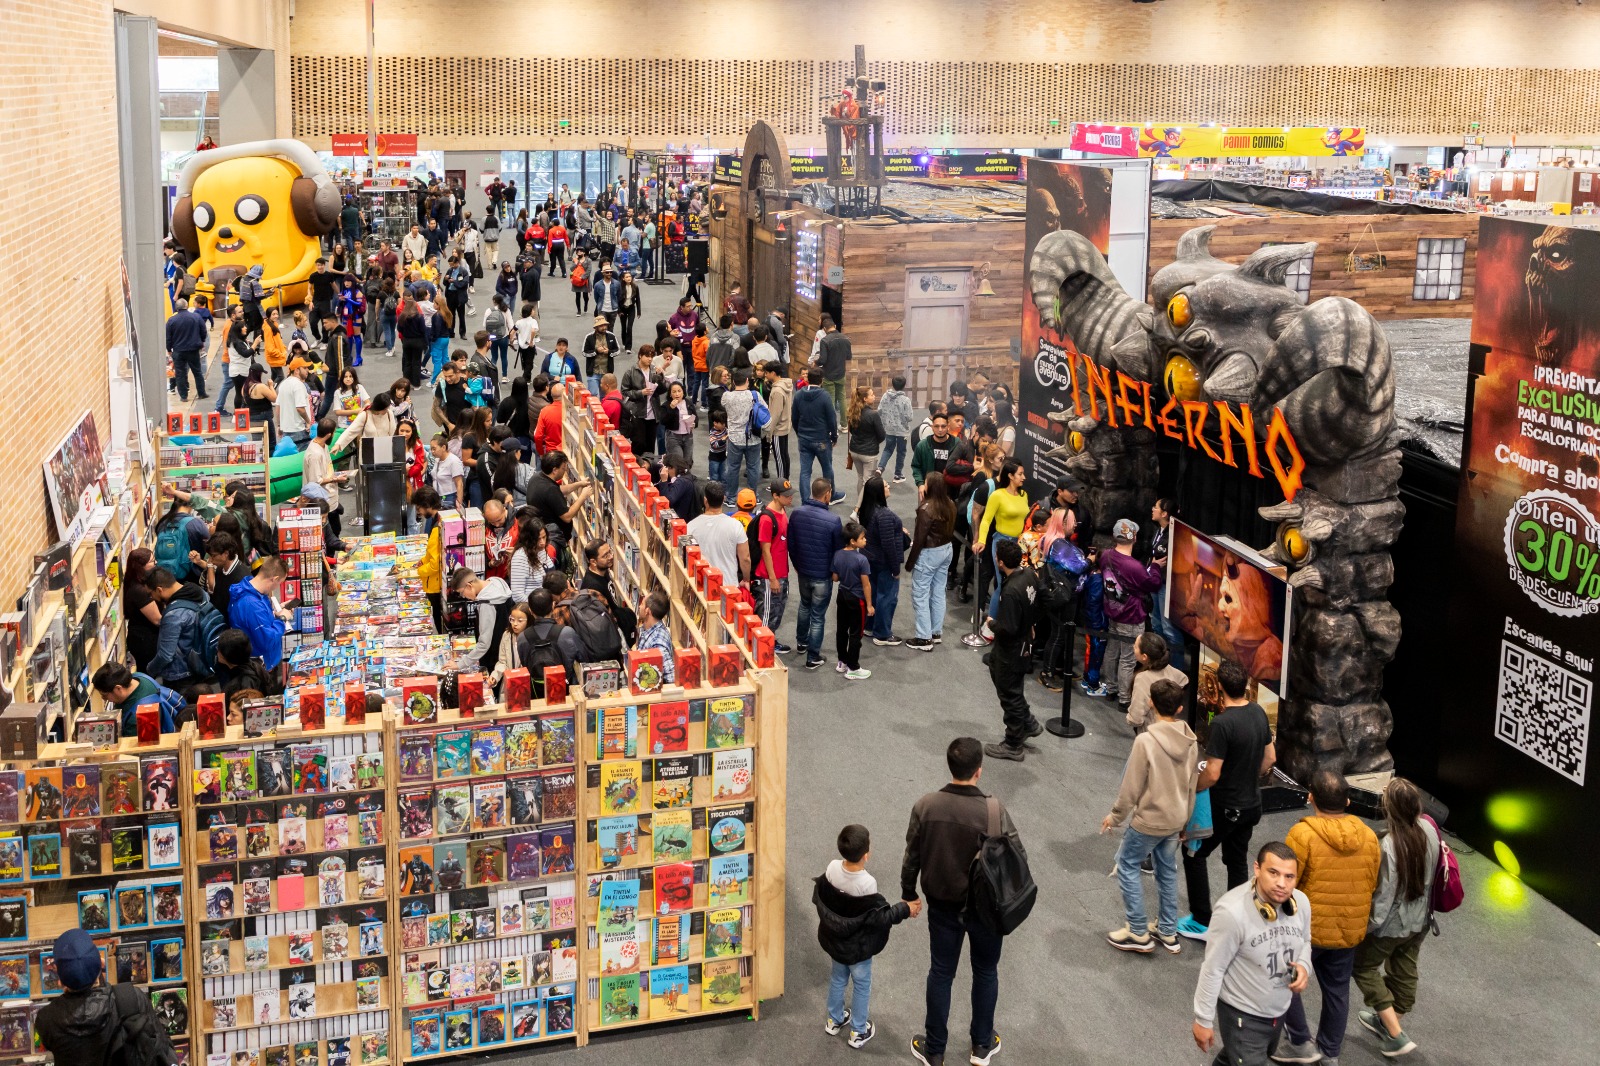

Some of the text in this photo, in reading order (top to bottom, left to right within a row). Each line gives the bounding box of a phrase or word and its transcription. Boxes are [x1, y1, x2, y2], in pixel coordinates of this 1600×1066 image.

[1252, 136, 1285, 149] COMICS
[1049, 353, 1058, 364] en
[1065, 349, 1306, 503] INFIERNO
[1518, 406, 1548, 426] PARA
[1551, 416, 1573, 434] UNA
[1495, 444, 1600, 491] Compra aho
[1515, 499, 1577, 536] Obten
[1517, 520, 1600, 600] 30%
[1509, 569, 1599, 614] DE DESCUENTO
[1504, 616, 1594, 675] Escanea aquí
[603, 935, 636, 943] MISTERIOSA
